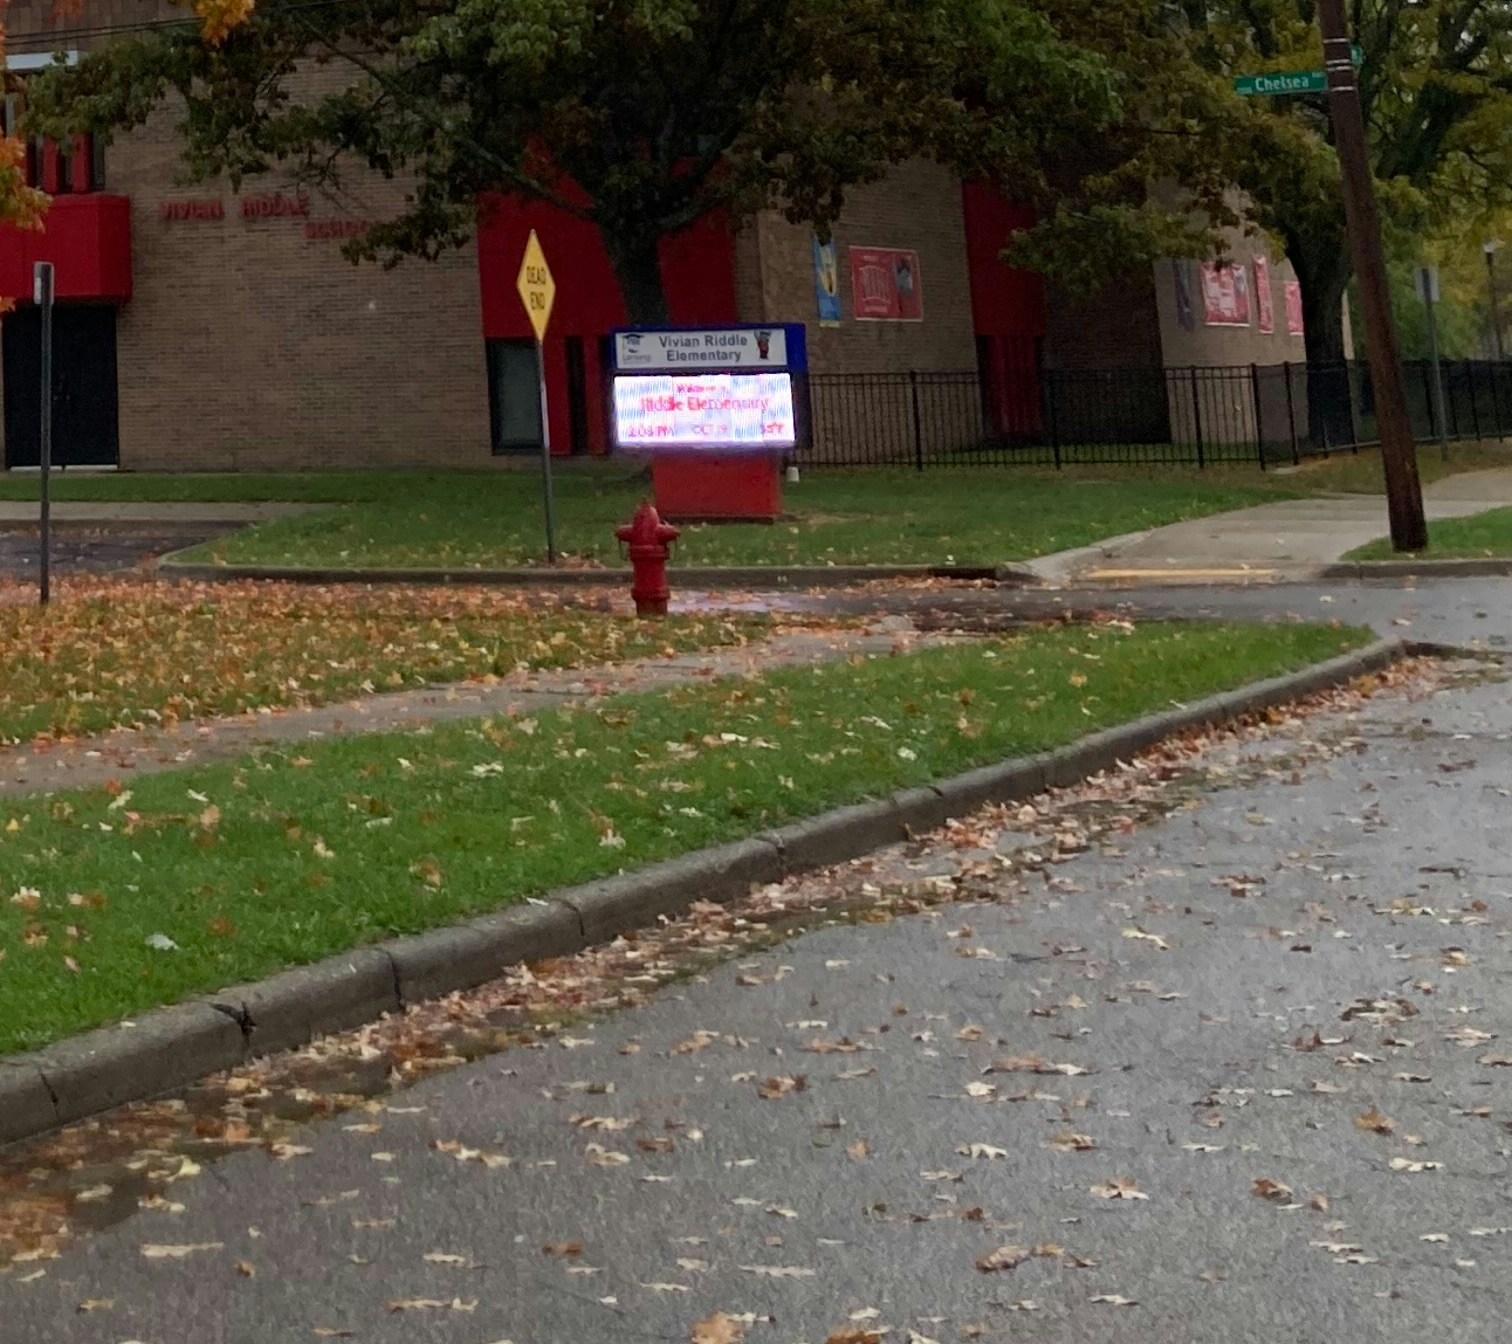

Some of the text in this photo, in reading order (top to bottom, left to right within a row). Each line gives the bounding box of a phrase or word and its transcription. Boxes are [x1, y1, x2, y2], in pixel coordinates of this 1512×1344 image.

[1254, 76, 1310, 92] Chelsea
[159, 196, 310, 220] VIVIAN RIDDLE
[530, 291, 546, 310] END
[658, 333, 748, 348] Vivian Riddle
[666, 348, 742, 363] Elementary
